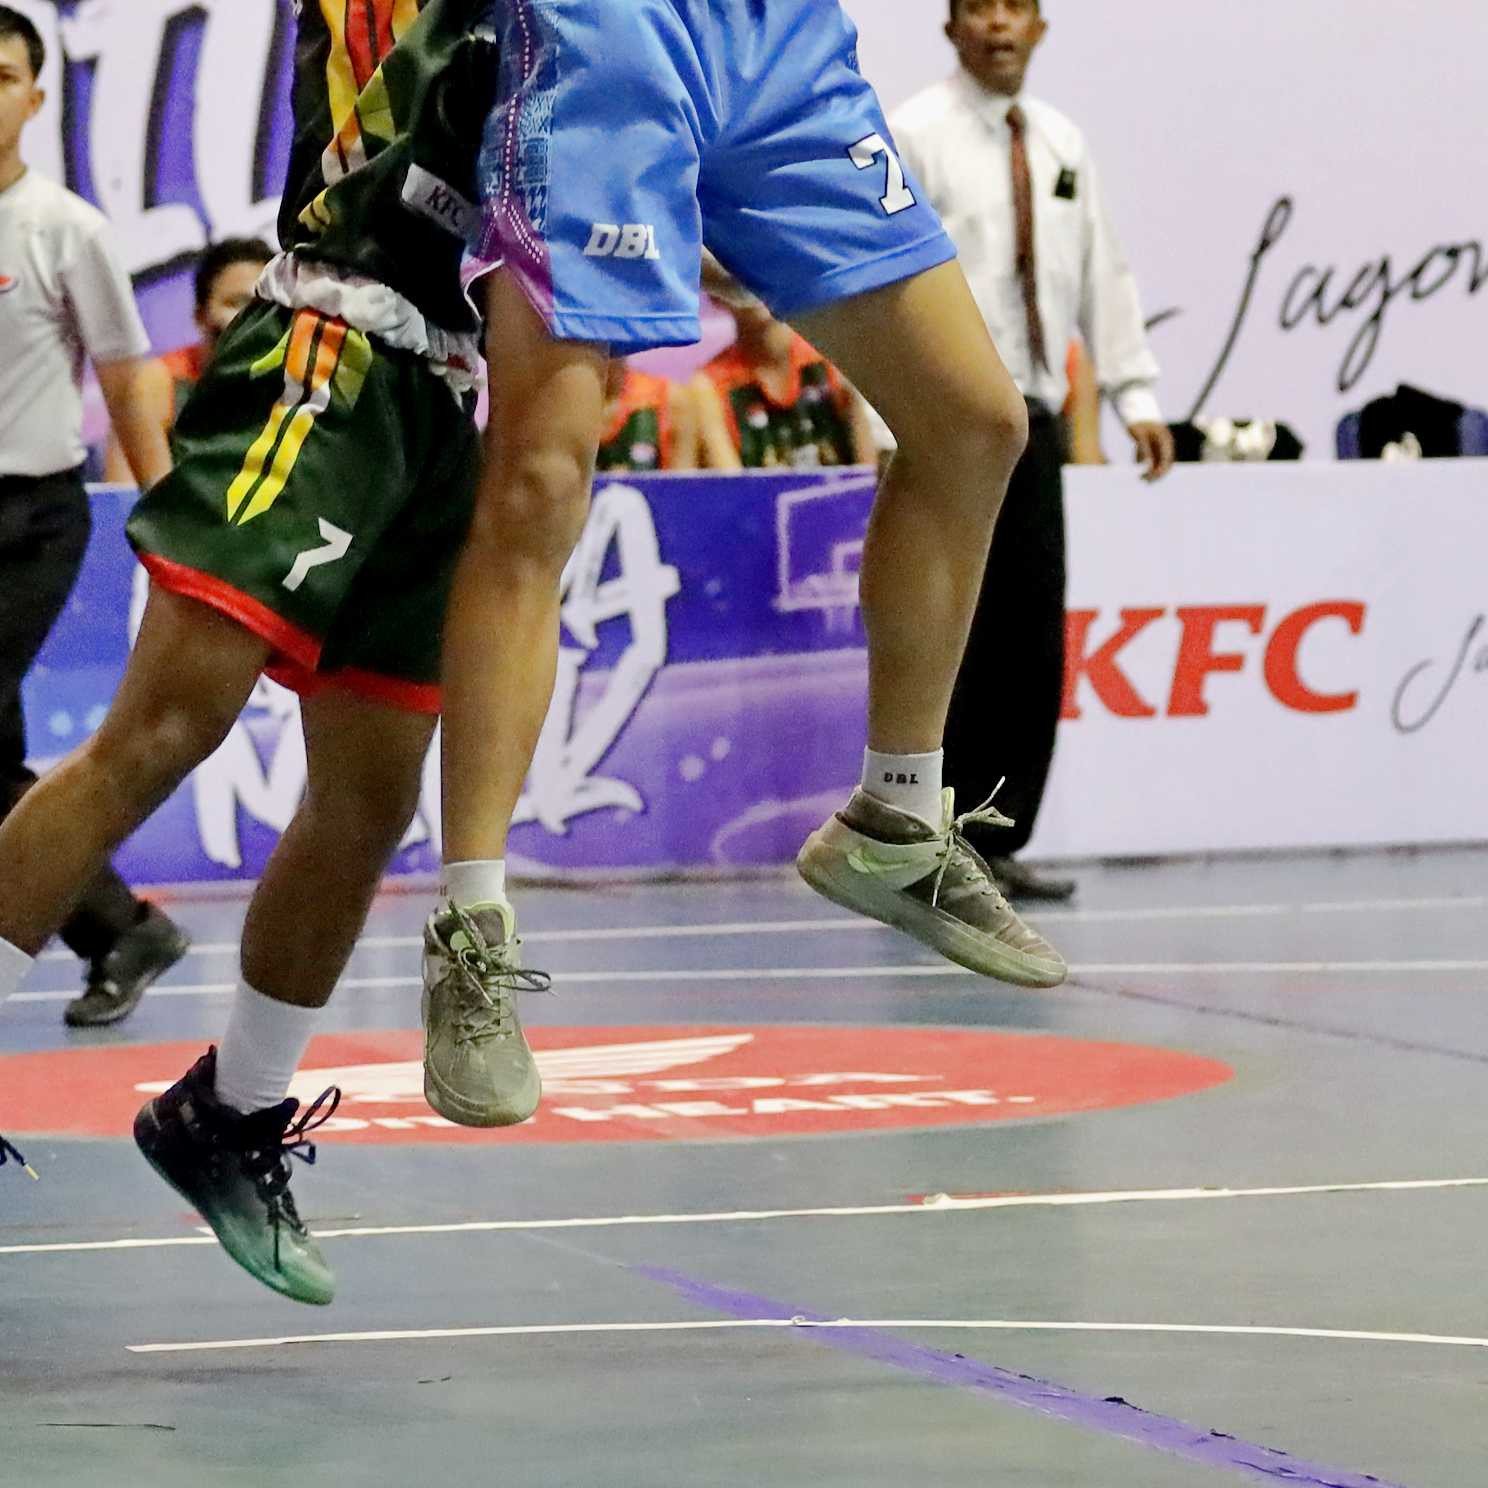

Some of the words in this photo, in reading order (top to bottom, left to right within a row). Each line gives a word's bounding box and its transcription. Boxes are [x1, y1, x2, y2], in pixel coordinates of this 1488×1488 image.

[847, 131, 918, 217] 7
[424, 184, 468, 228] KFC
[582, 223, 661, 260] DBL
[281, 516, 354, 593] 7
[1057, 599, 1367, 722] KFC
[883, 772, 919, 784] DBL
[551, 1089, 1036, 1123] HEART.
